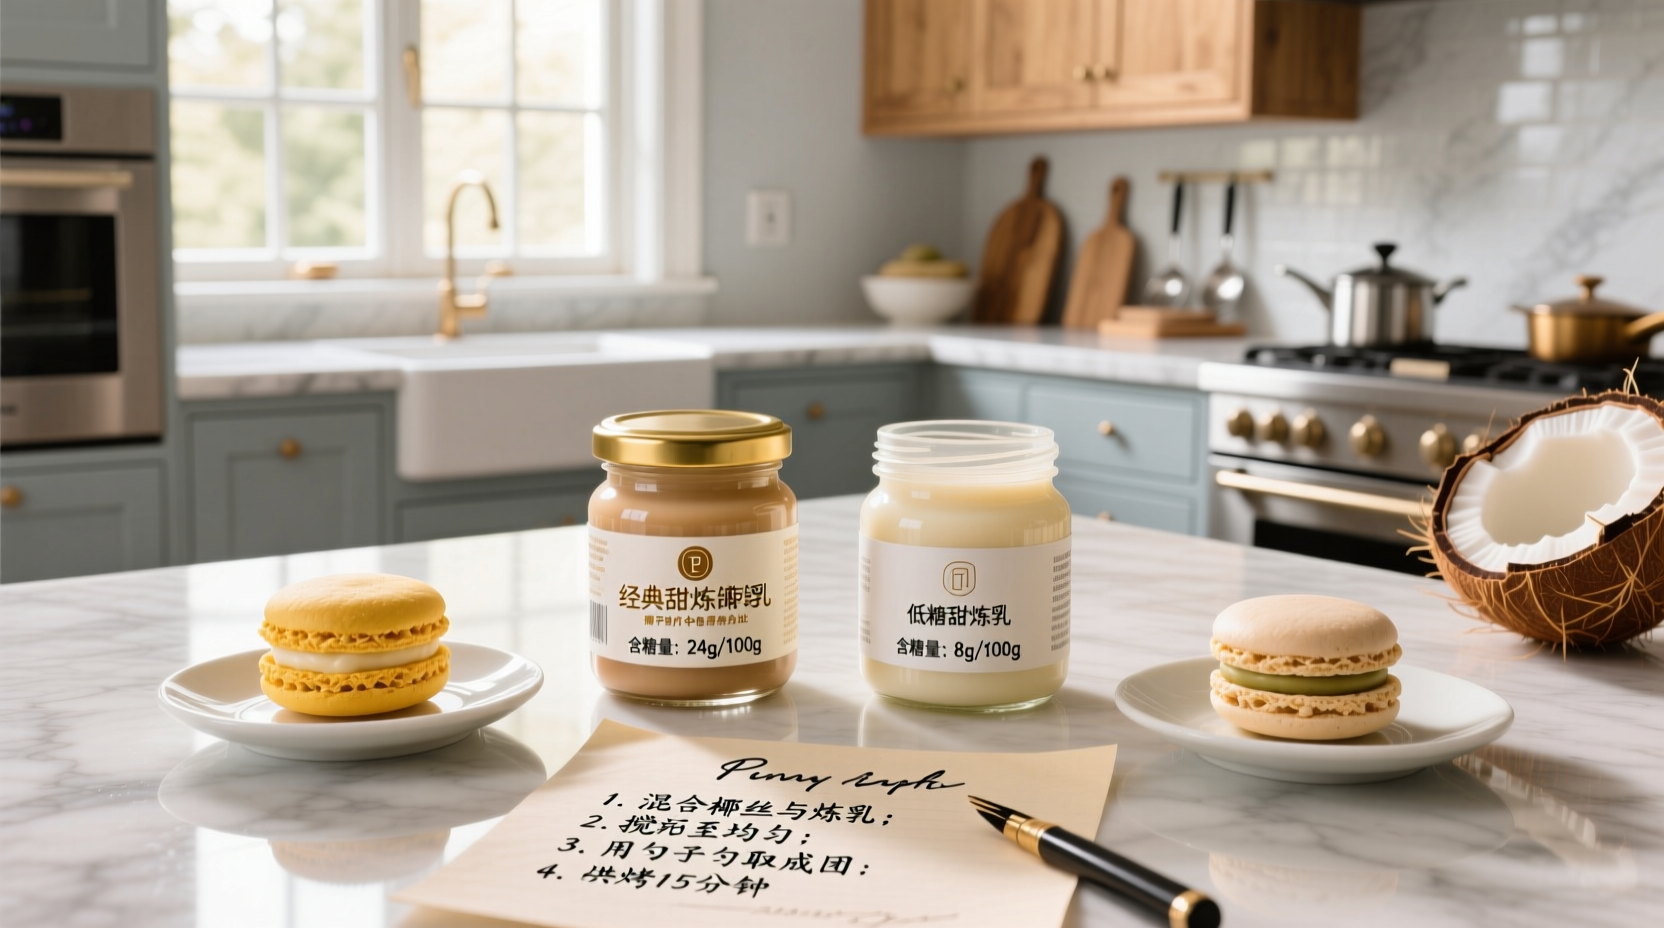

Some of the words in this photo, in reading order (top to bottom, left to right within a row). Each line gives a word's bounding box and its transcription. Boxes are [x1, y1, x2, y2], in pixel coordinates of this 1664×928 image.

[687, 636, 762, 660] 24g/100g
[953, 640, 1021, 662] 8g/100g
[602, 792, 623, 807] 1.
[579, 814, 607, 830] 2.
[557, 837, 584, 854] 3.
[536, 863, 562, 880] 4.
